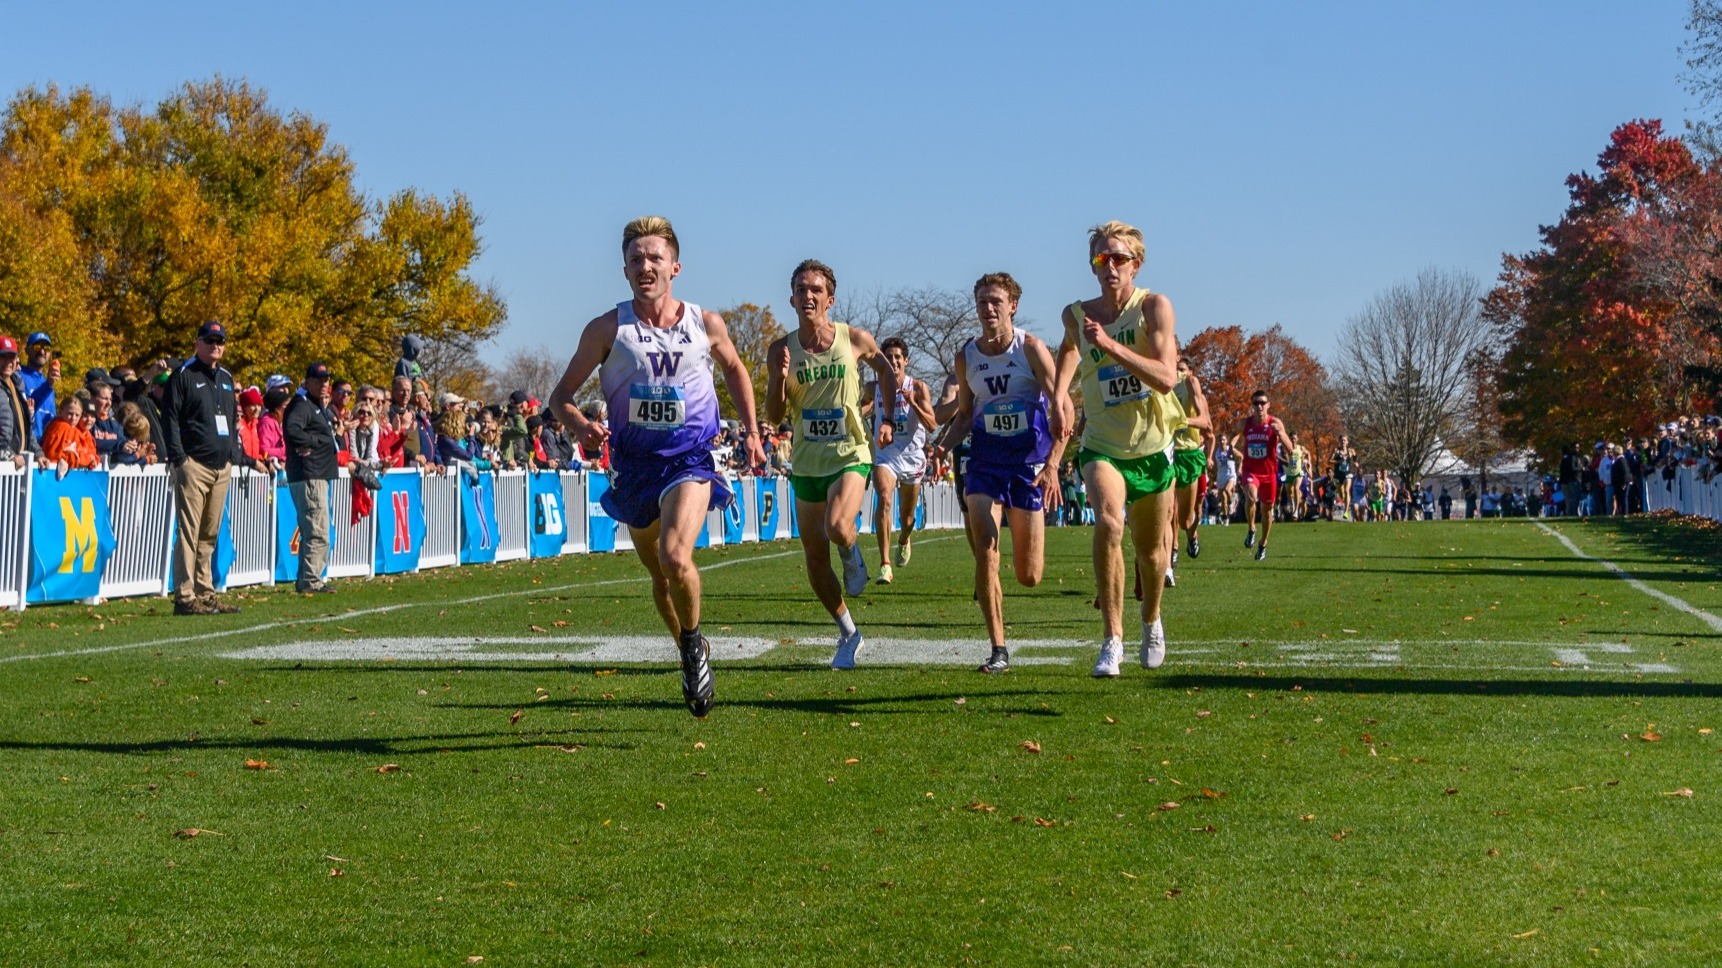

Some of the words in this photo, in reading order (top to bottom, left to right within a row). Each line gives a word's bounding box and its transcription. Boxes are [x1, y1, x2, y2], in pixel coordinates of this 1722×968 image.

[646, 351, 684, 378] W
[796, 364, 846, 385] OREGON
[984, 374, 1011, 396] W
[1108, 375, 1142, 398] 429
[637, 401, 677, 423] 495
[993, 414, 1019, 431] 497
[809, 420, 839, 436] 432
[762, 491, 773, 526] P
[391, 490, 411, 554] N
[58, 496, 99, 574] M
